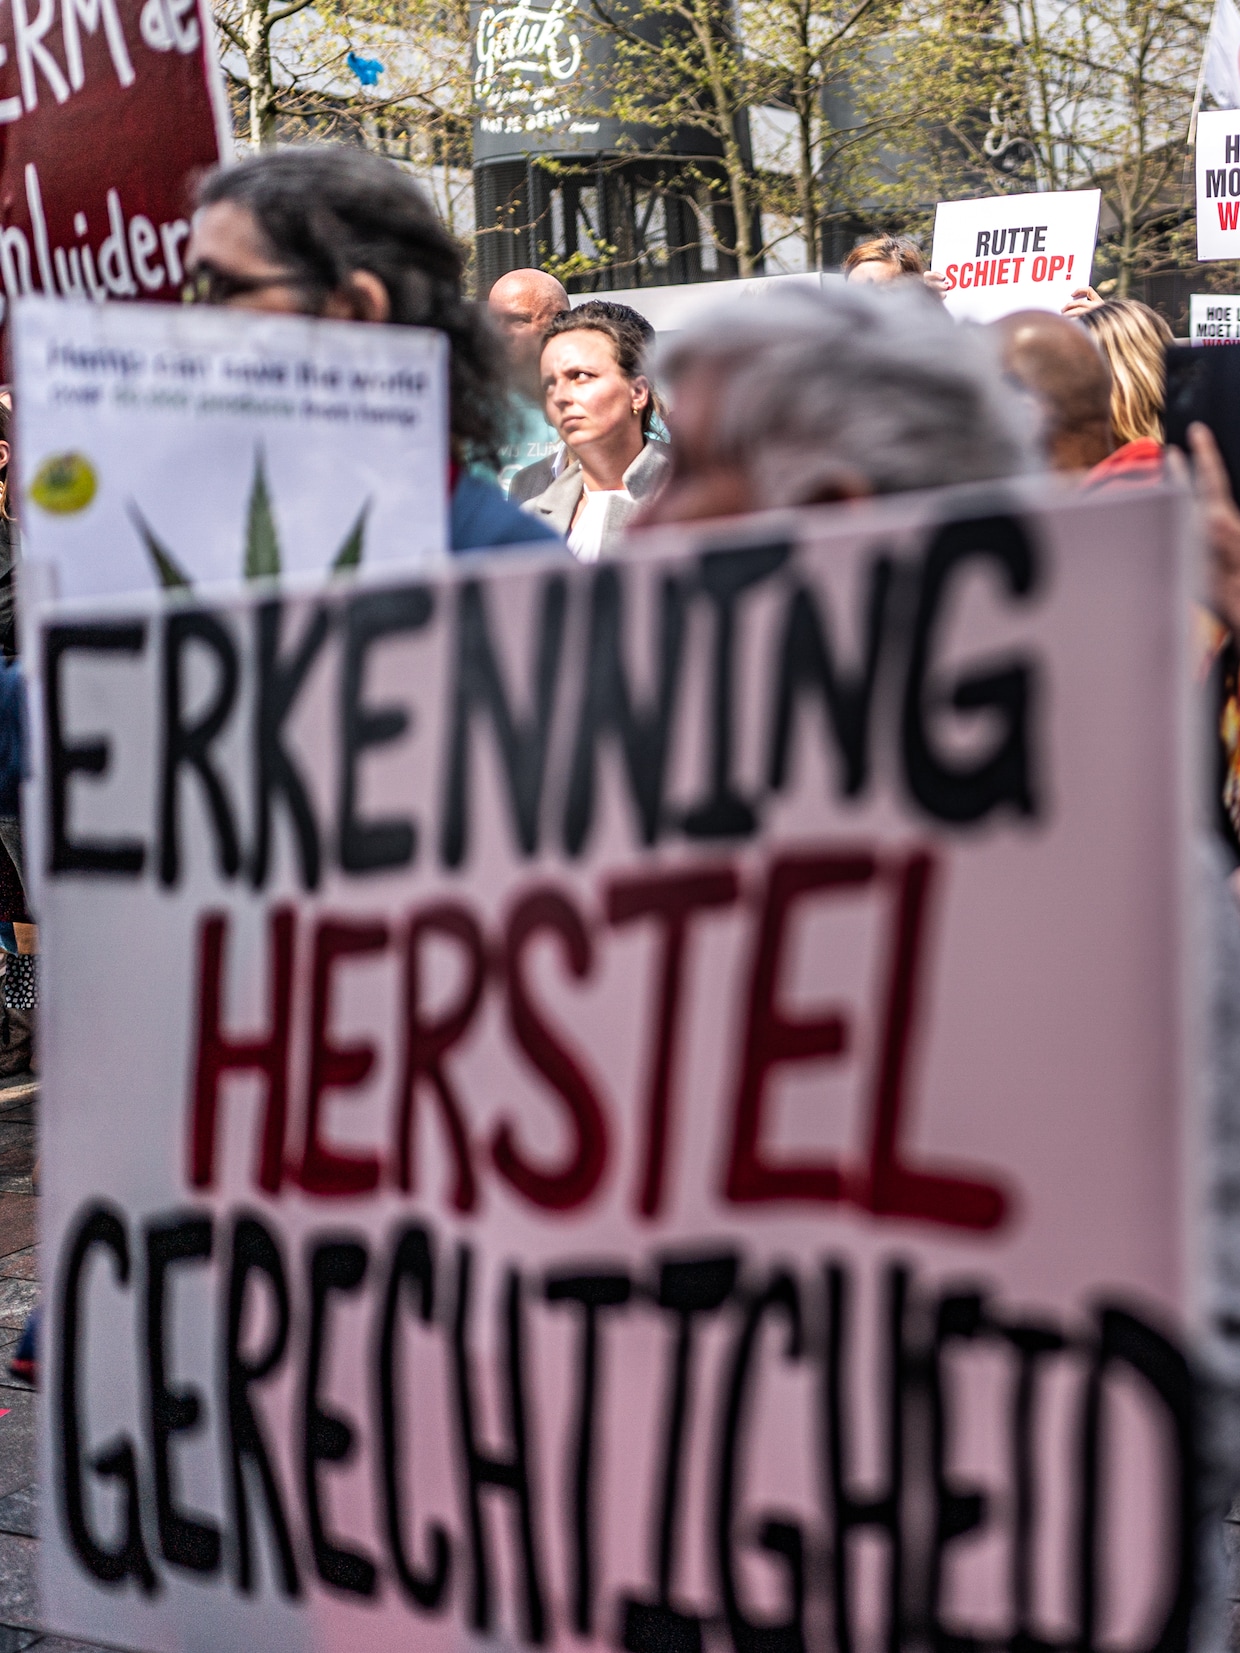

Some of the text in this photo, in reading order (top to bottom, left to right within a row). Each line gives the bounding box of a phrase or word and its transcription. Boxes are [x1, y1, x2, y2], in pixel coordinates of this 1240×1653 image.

[975, 225, 1048, 257] RUTTE
[945, 254, 1075, 290] SCHIET OP!
[1196, 323, 1232, 337] MOET
[1207, 307, 1232, 321] HOE
[42, 511, 1046, 889] ERKENNING
[185, 844, 1020, 1234] HERSTEL
[55, 1198, 1203, 1653] GERECHTIGHEID
